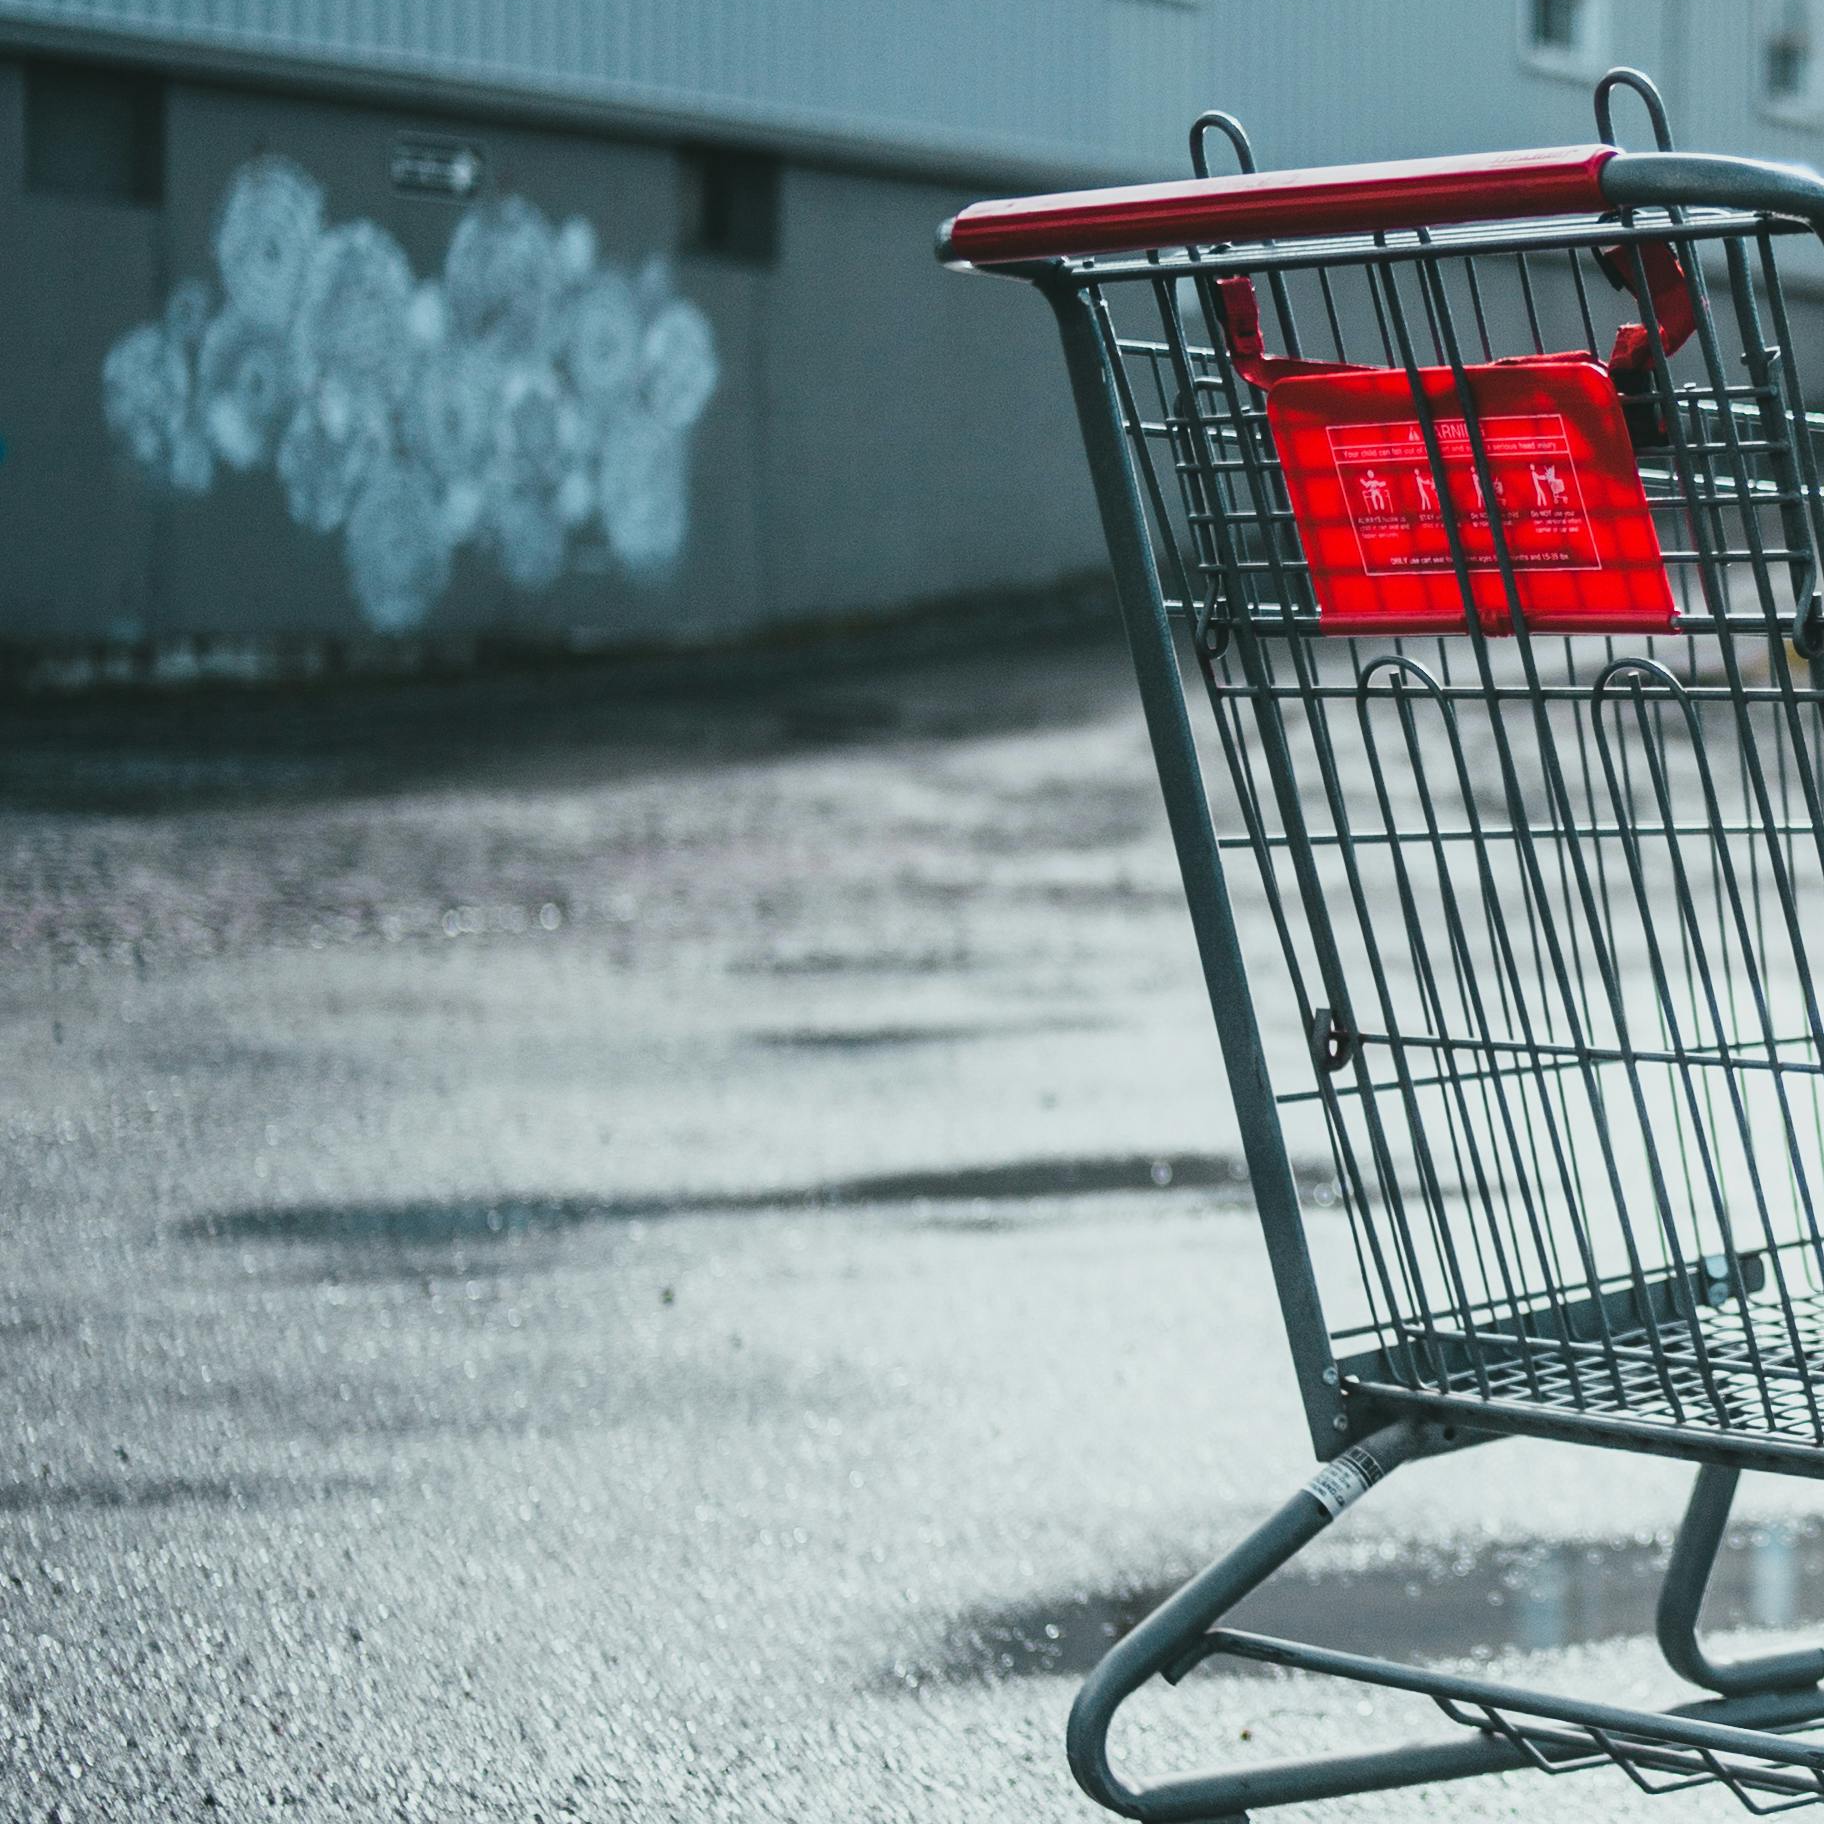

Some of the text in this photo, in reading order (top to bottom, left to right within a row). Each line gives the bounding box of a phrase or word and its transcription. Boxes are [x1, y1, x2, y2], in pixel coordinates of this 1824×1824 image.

[1343, 450, 1359, 458] Your
[1360, 449, 1377, 457] child
[1492, 442, 1518, 450] serious
[1518, 441, 1536, 450] head
